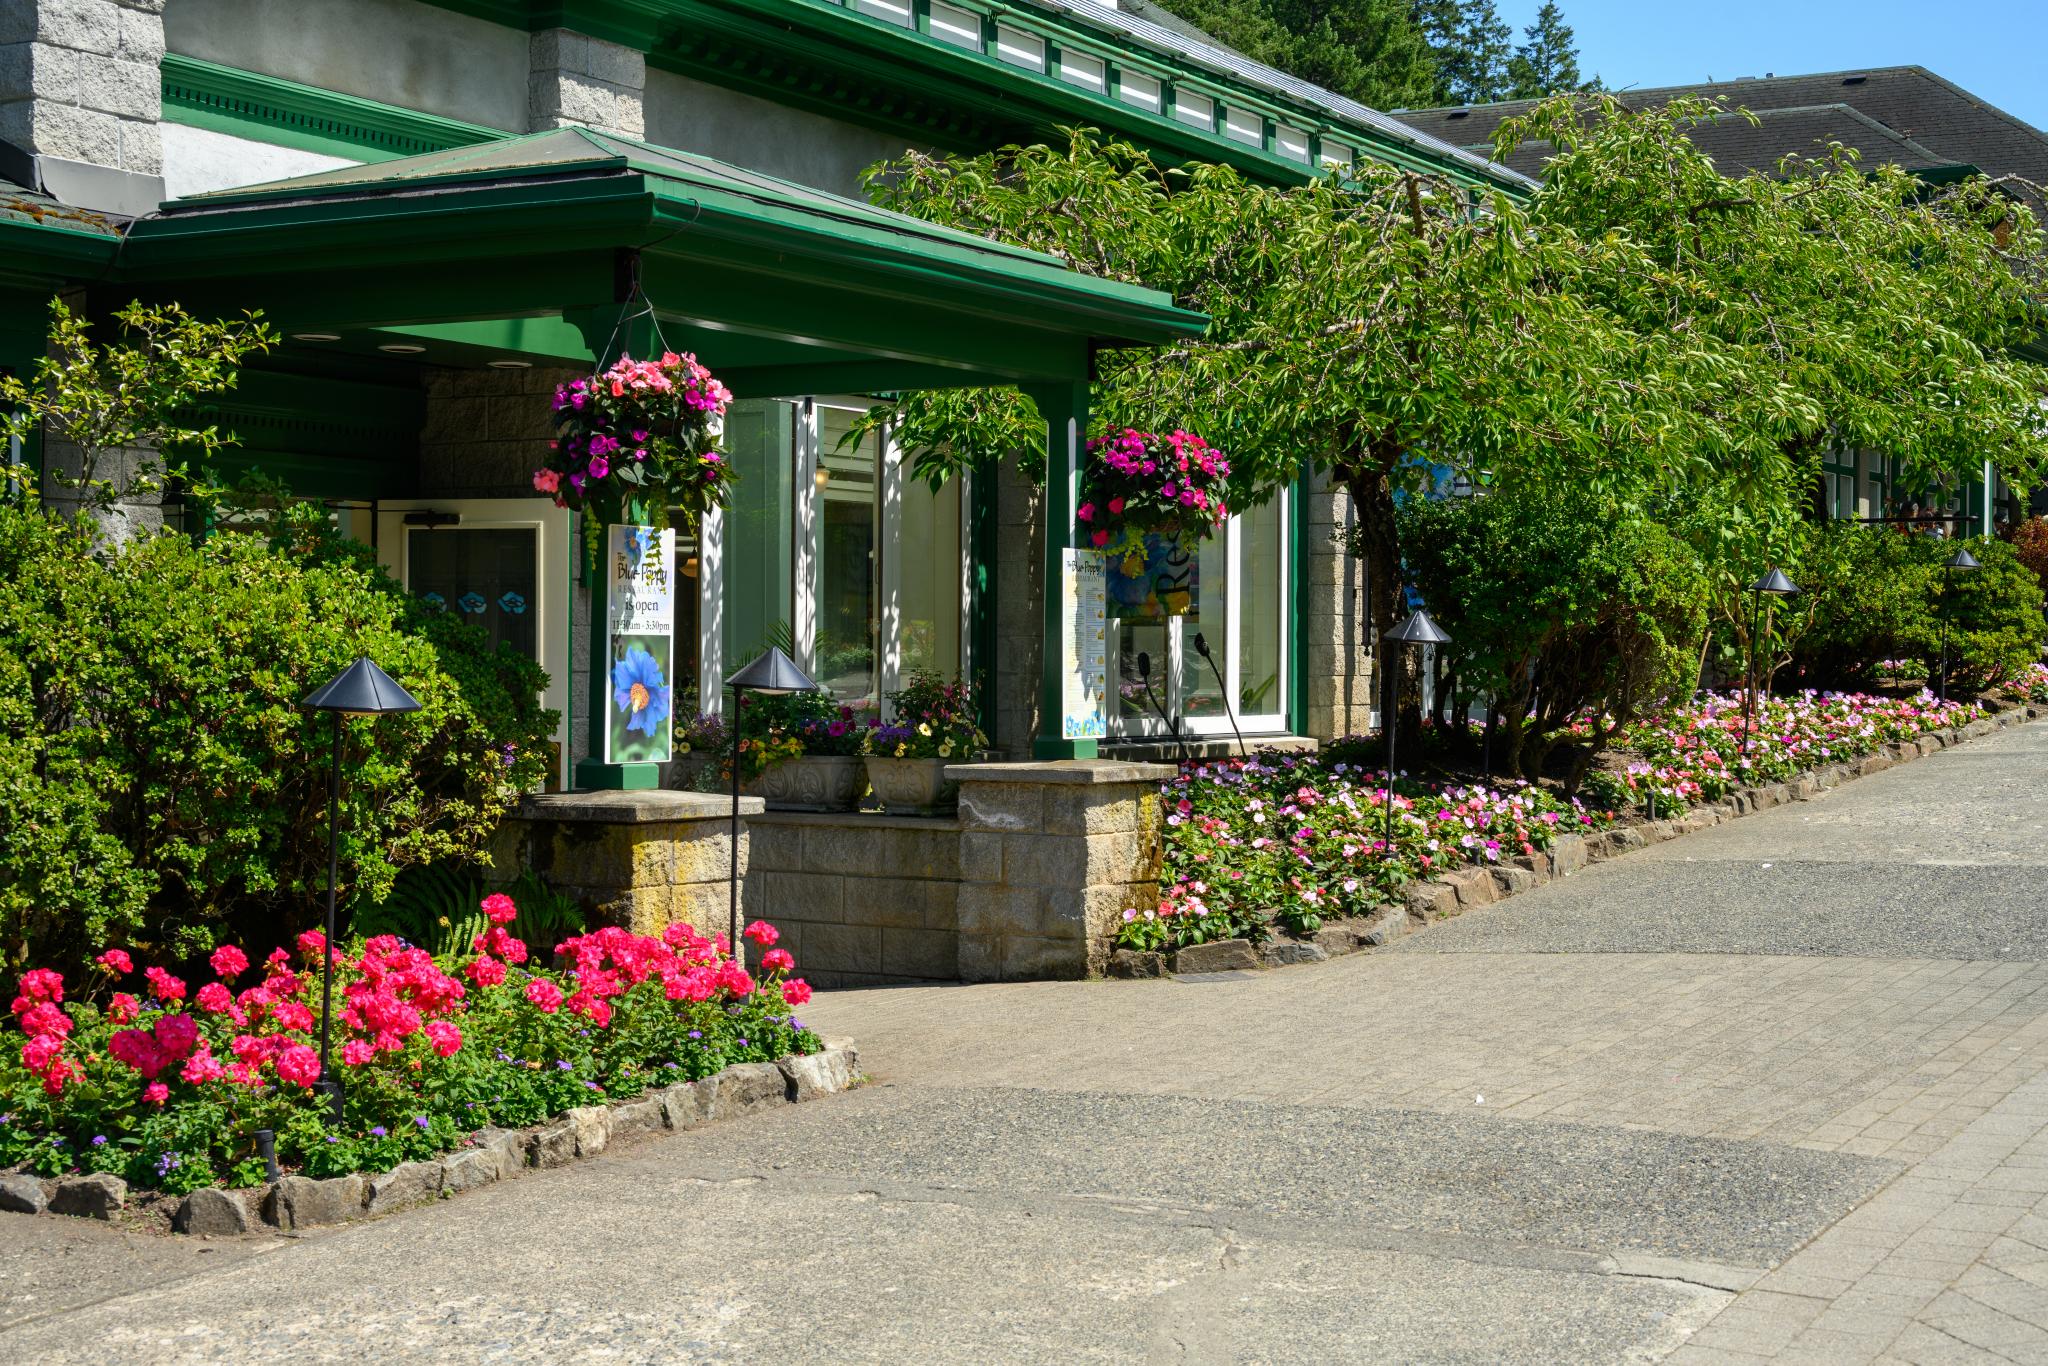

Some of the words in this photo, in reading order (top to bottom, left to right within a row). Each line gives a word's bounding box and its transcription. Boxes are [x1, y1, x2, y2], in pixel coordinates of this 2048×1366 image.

[617, 562, 640, 580] Blue
[642, 563, 667, 586] Poppy
[617, 584, 666, 594] RESTAURAN
[625, 597, 634, 611] is
[635, 601, 659, 615] open
